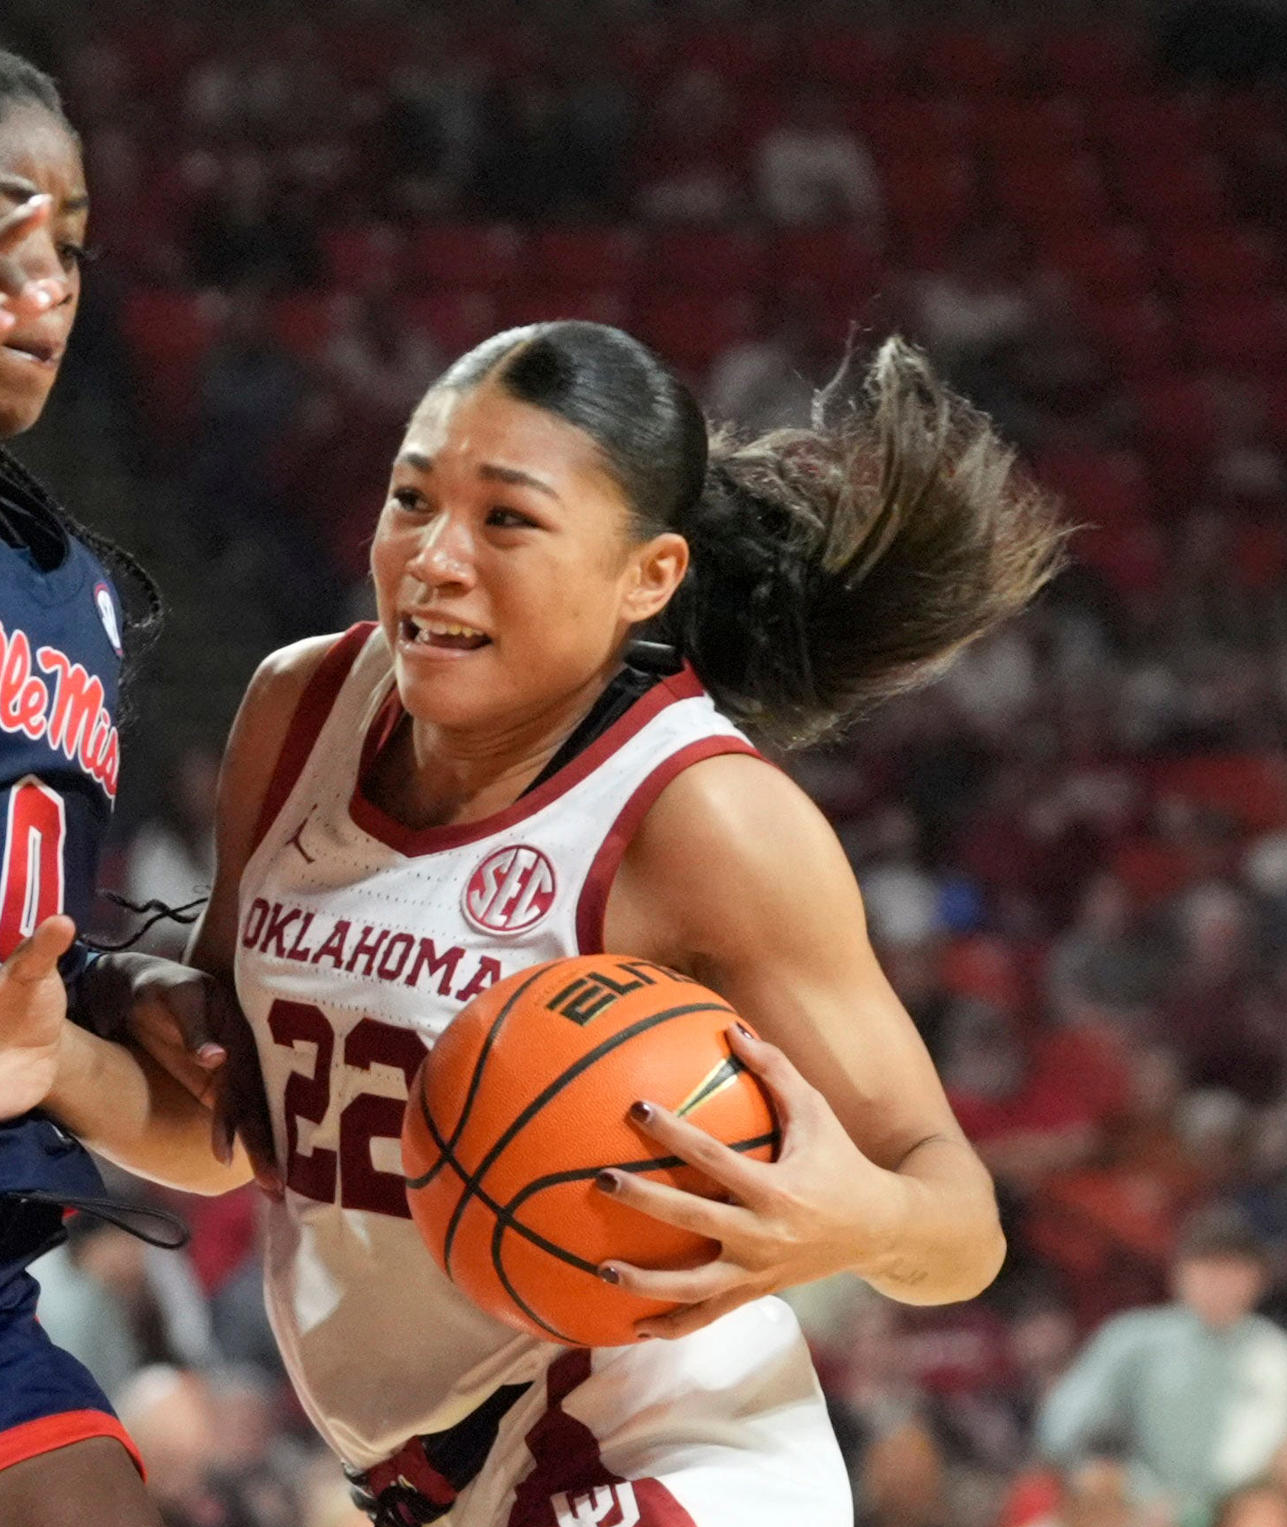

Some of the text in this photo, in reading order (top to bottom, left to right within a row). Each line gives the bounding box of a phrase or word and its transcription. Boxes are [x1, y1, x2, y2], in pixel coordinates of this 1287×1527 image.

[37, 646, 120, 799] Mis
[468, 847, 554, 928] SEC
[242, 897, 502, 1002] OKLAHOMA
[546, 961, 698, 1027] ELIT
[267, 998, 436, 1220] 22
